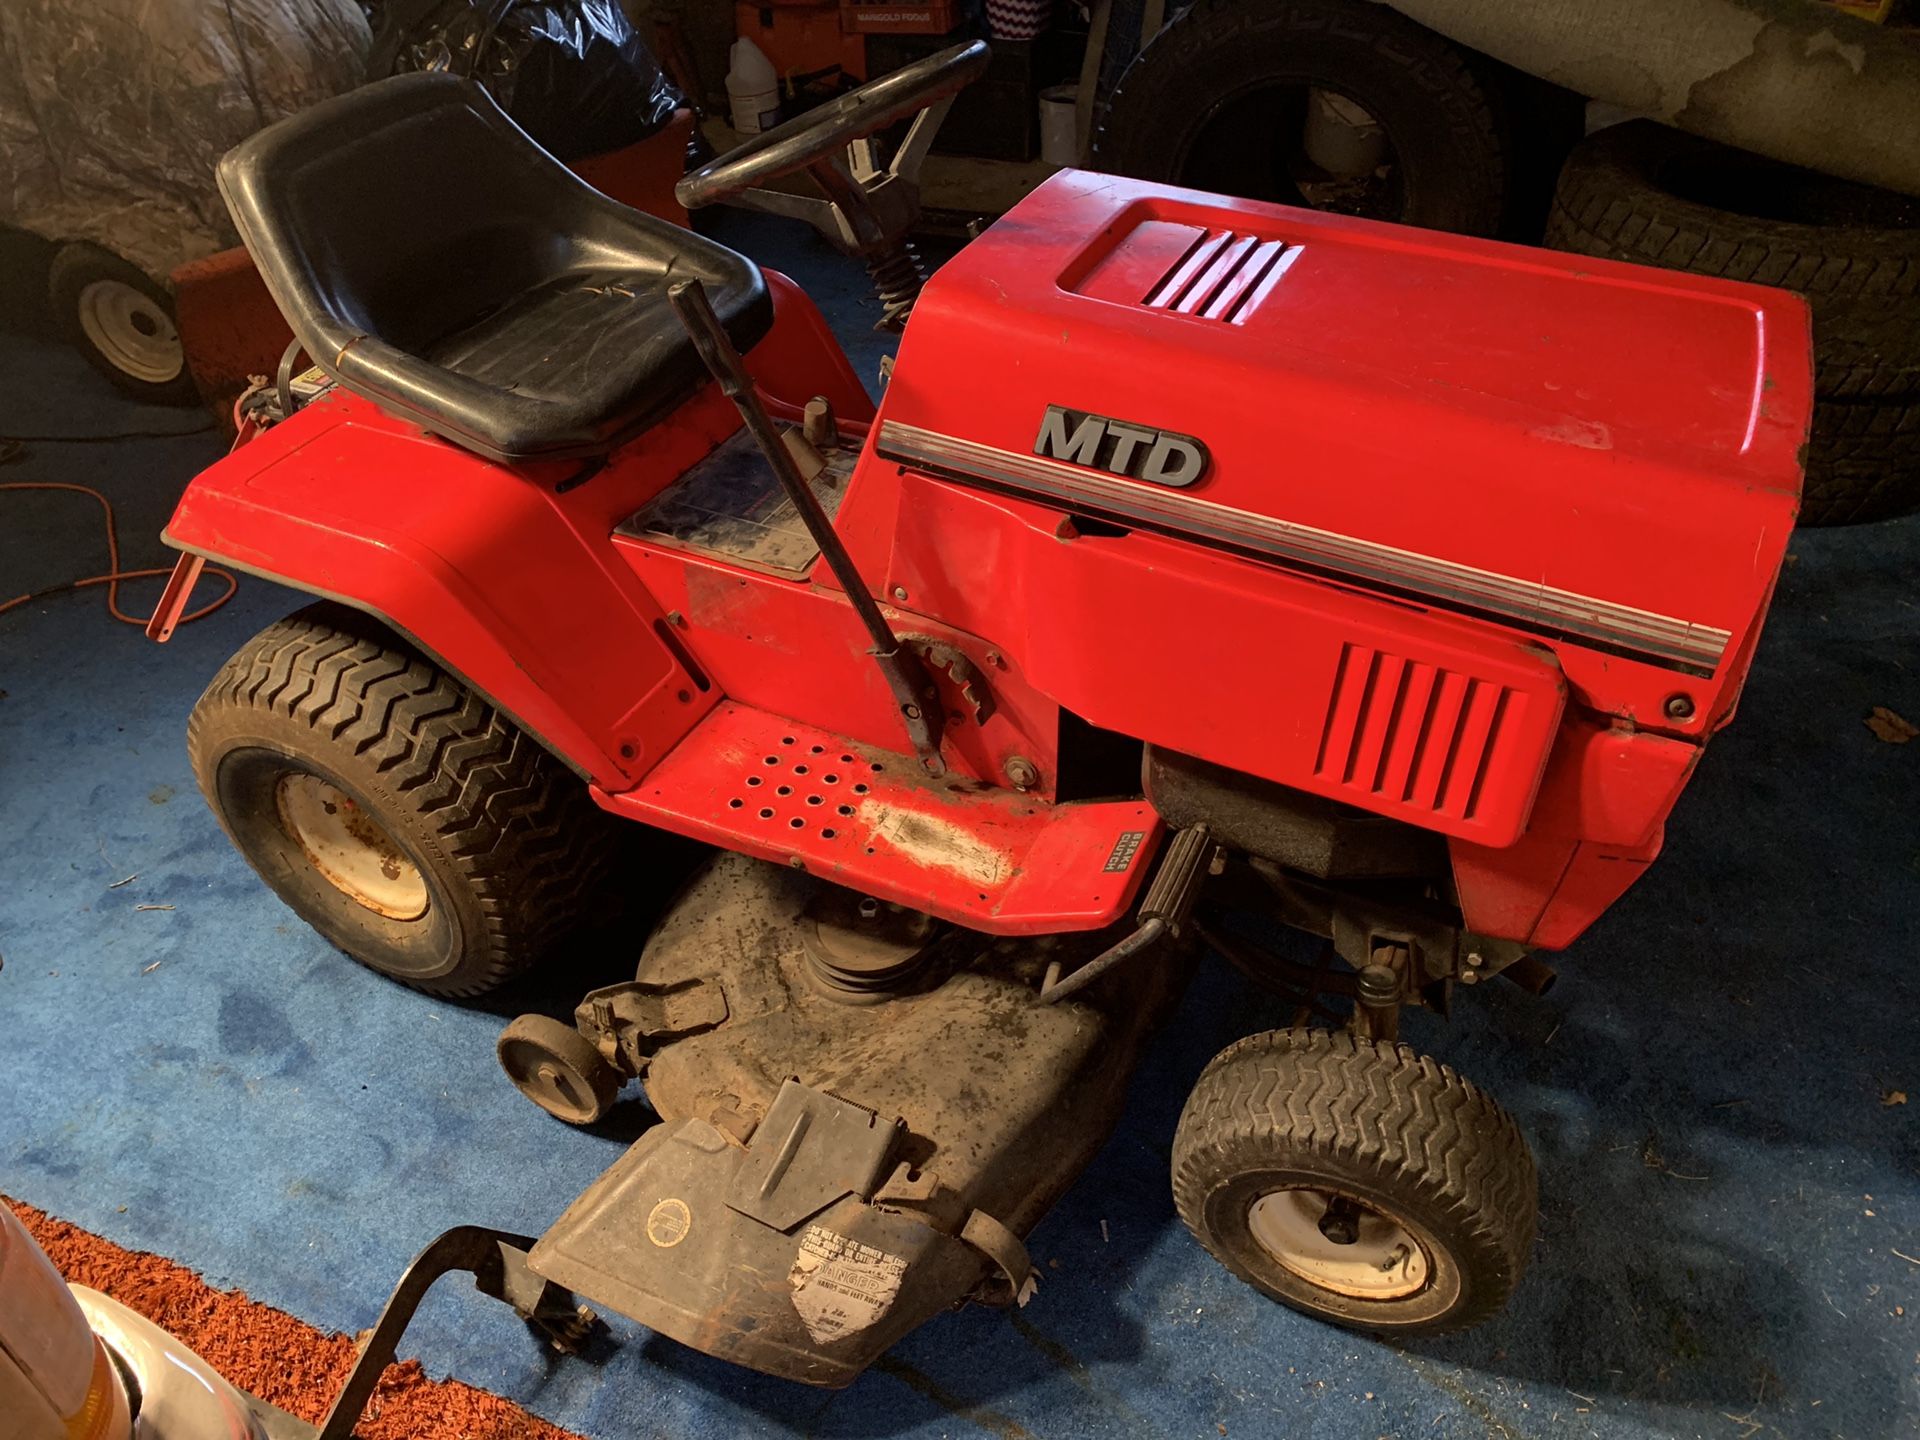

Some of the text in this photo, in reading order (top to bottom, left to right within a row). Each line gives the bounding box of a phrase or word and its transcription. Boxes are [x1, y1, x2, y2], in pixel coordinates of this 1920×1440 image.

[1034, 405, 1203, 487] MTD
[1105, 833, 1131, 870] CLUTCH
[1117, 833, 1143, 870] BRAKE
